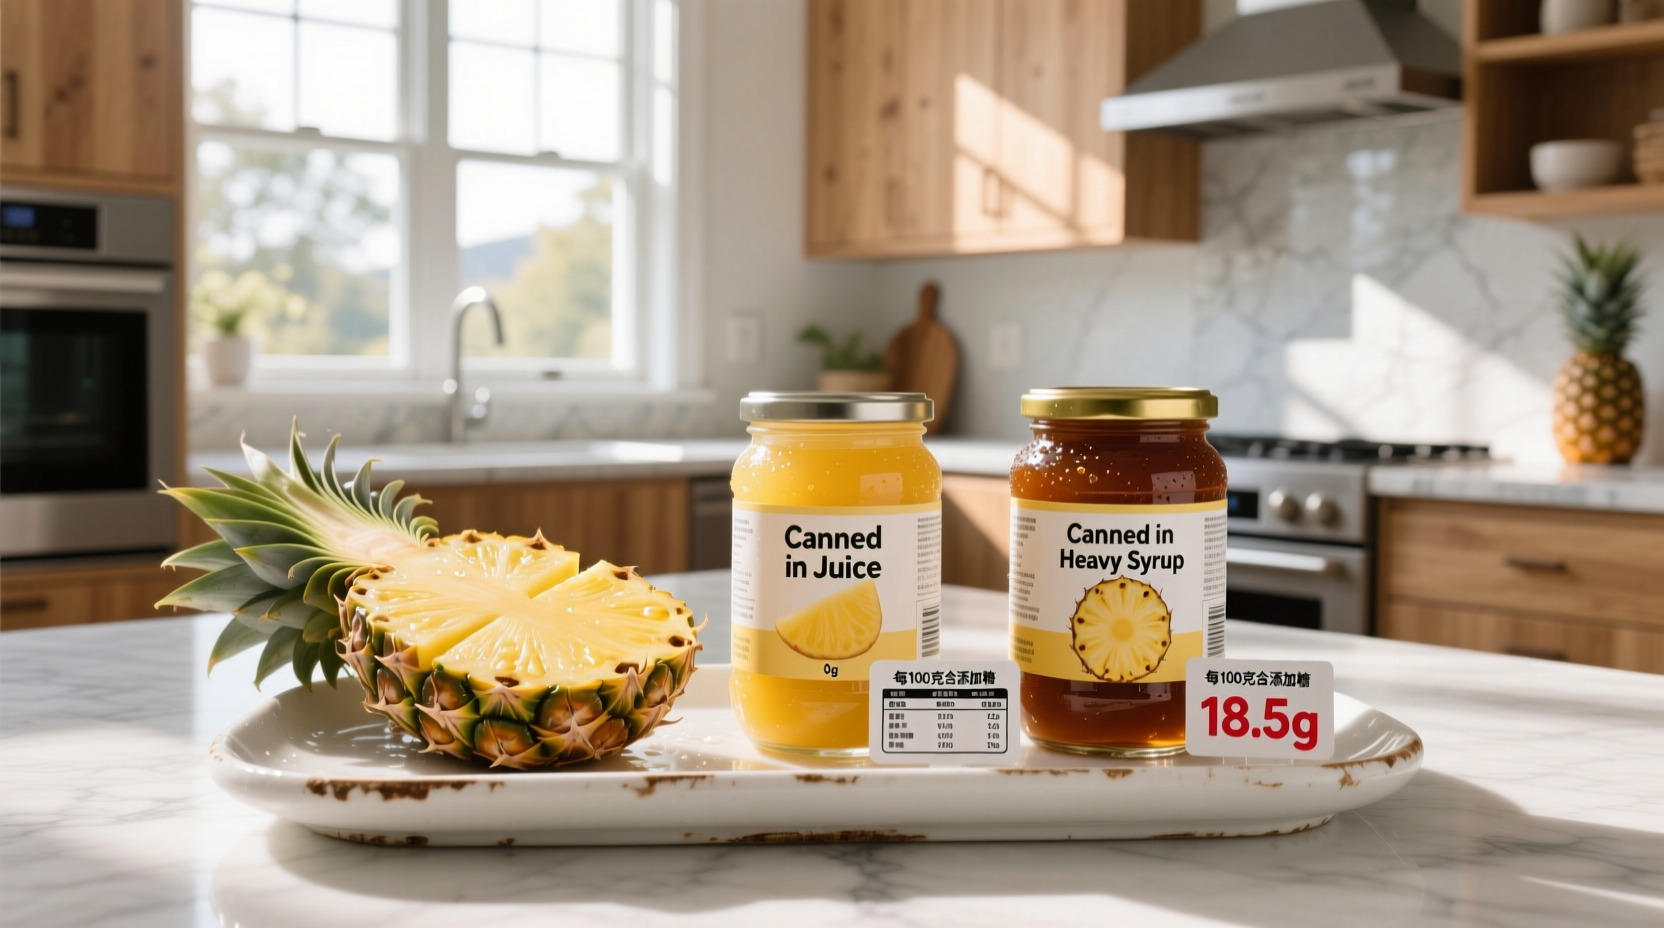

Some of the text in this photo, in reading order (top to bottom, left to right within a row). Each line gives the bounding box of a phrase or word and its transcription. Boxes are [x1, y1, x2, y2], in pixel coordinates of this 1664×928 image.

[784, 524, 882, 550] Canned
[1066, 522, 1174, 545] Canned in
[785, 553, 882, 579] in Juice
[1060, 548, 1185, 576] Heavy Syrup
[823, 663, 839, 678] 0g
[1200, 695, 1319, 752] 18.5g
